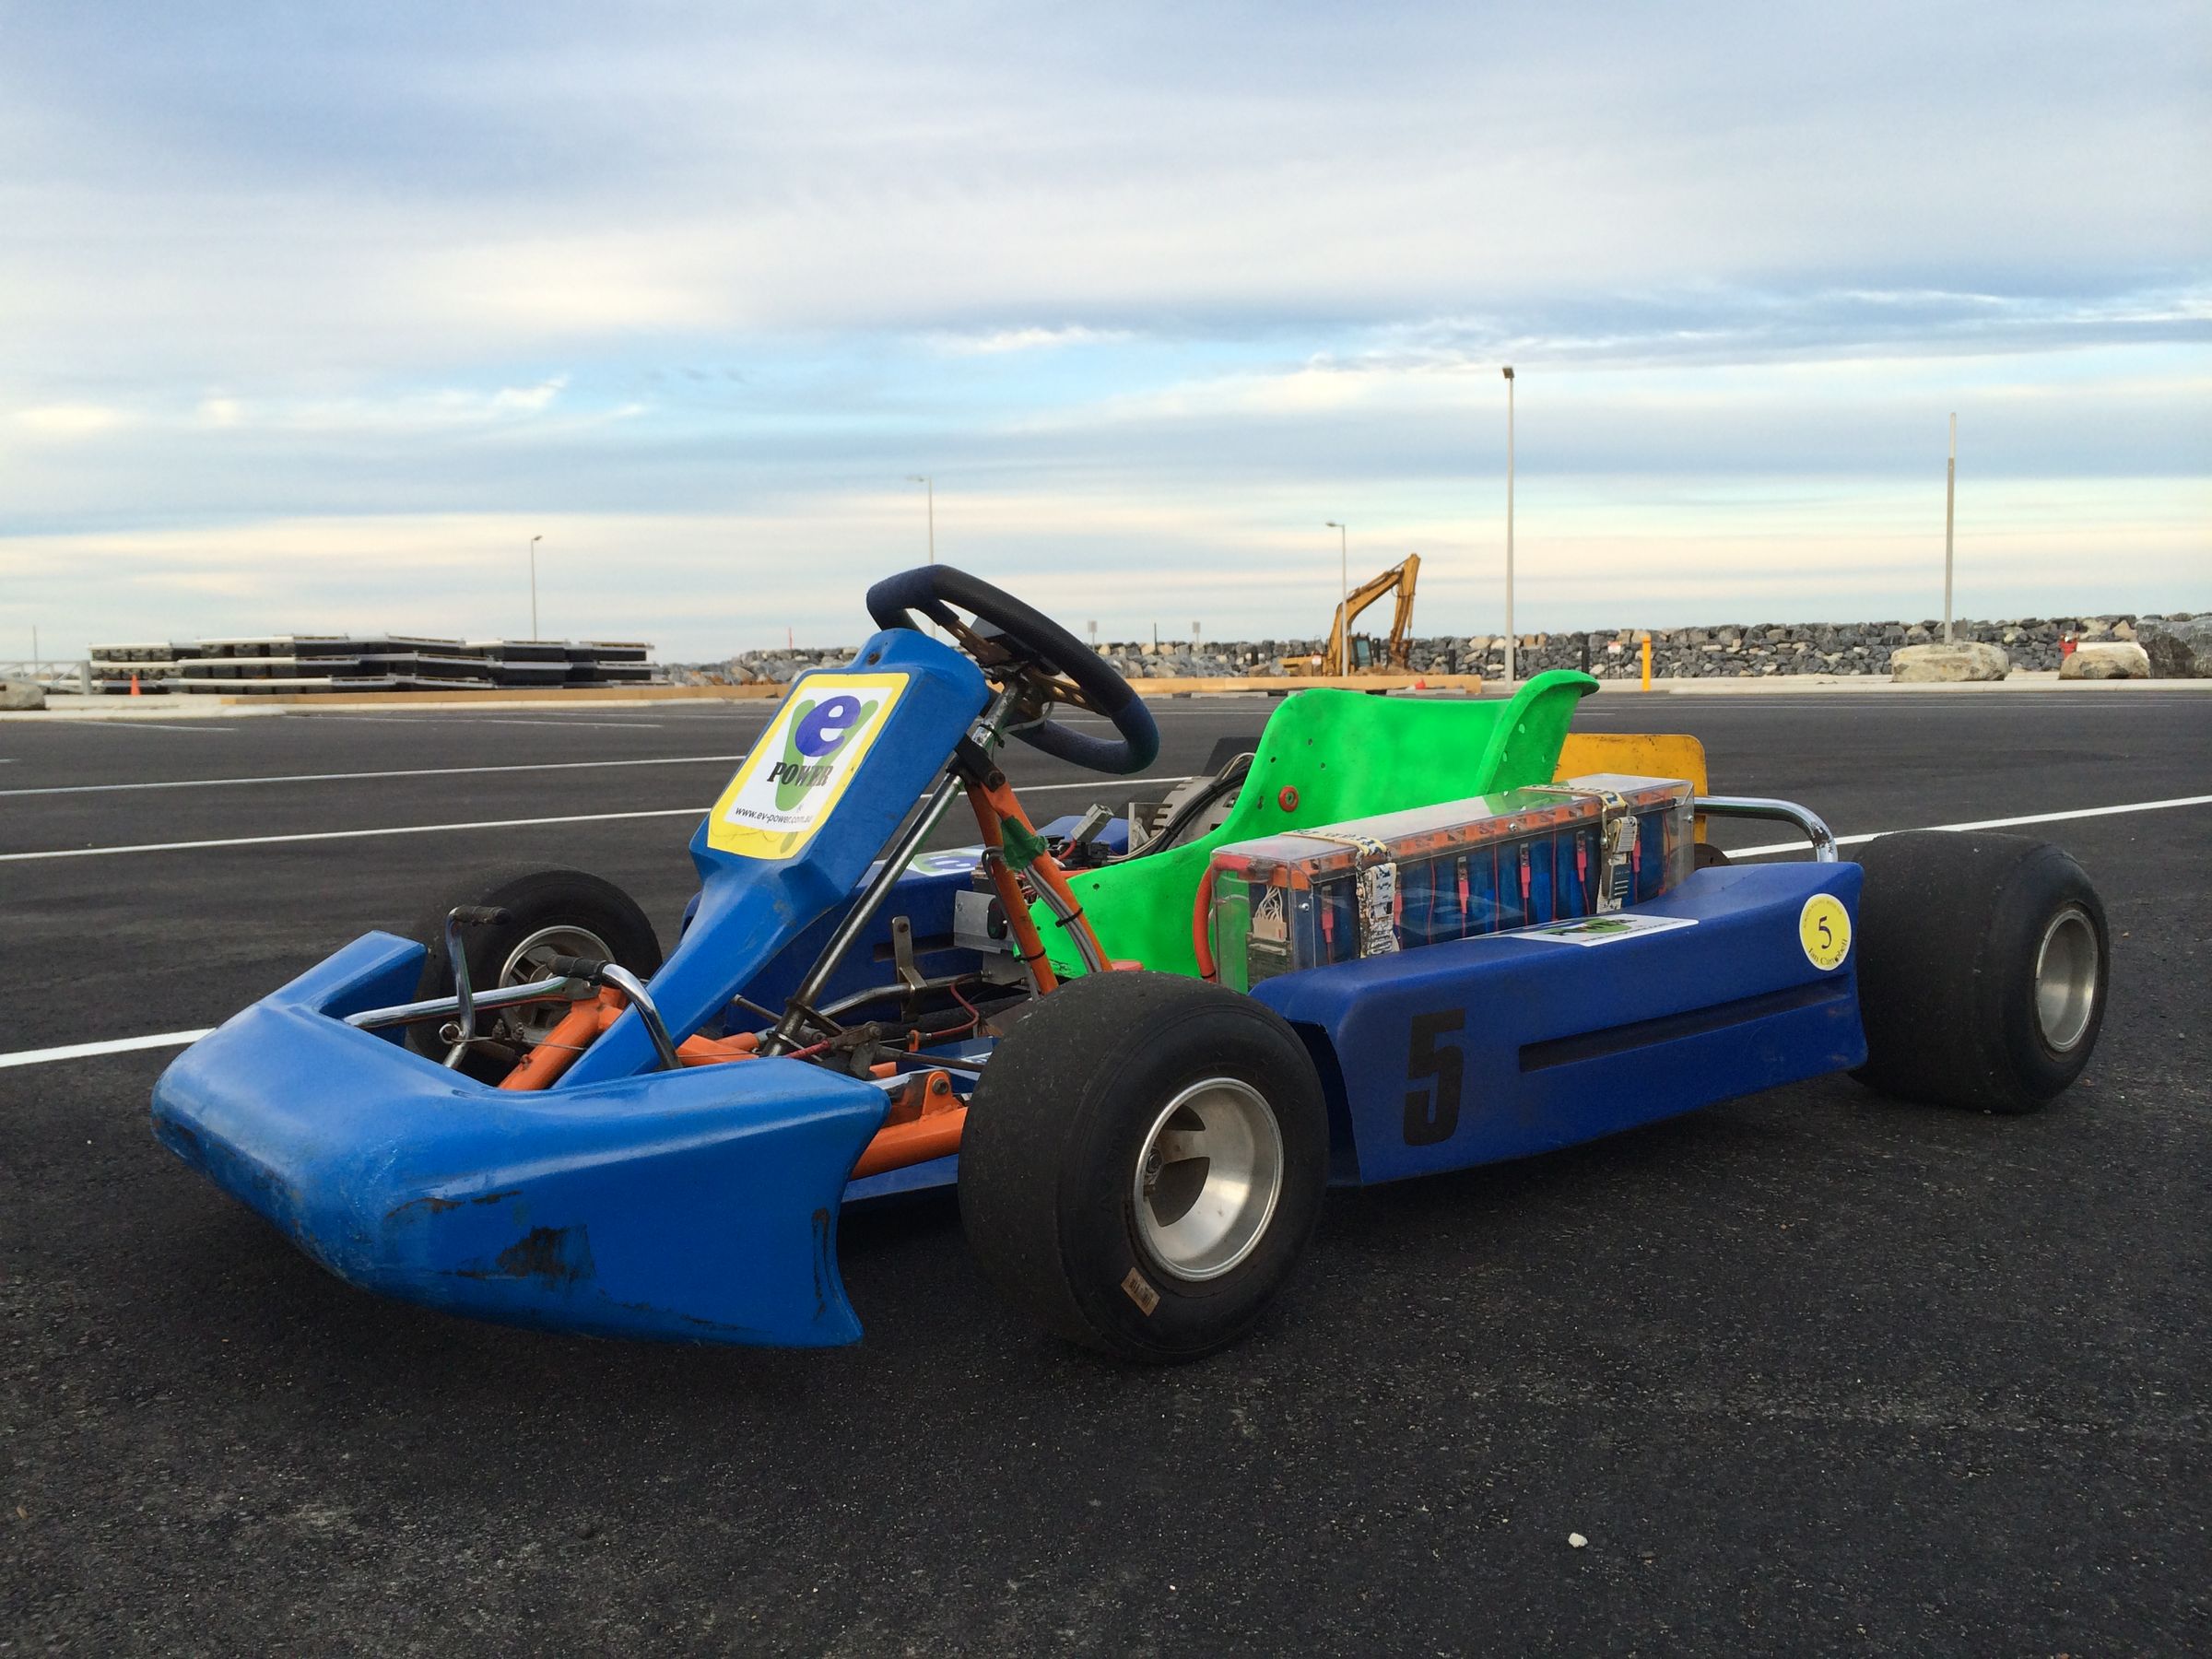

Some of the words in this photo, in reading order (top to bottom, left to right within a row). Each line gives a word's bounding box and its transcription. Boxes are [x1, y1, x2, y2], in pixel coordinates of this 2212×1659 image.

[767, 762, 833, 786] POWER
[1818, 916, 1831, 949] 5
[1403, 1008, 1466, 1147] 5
